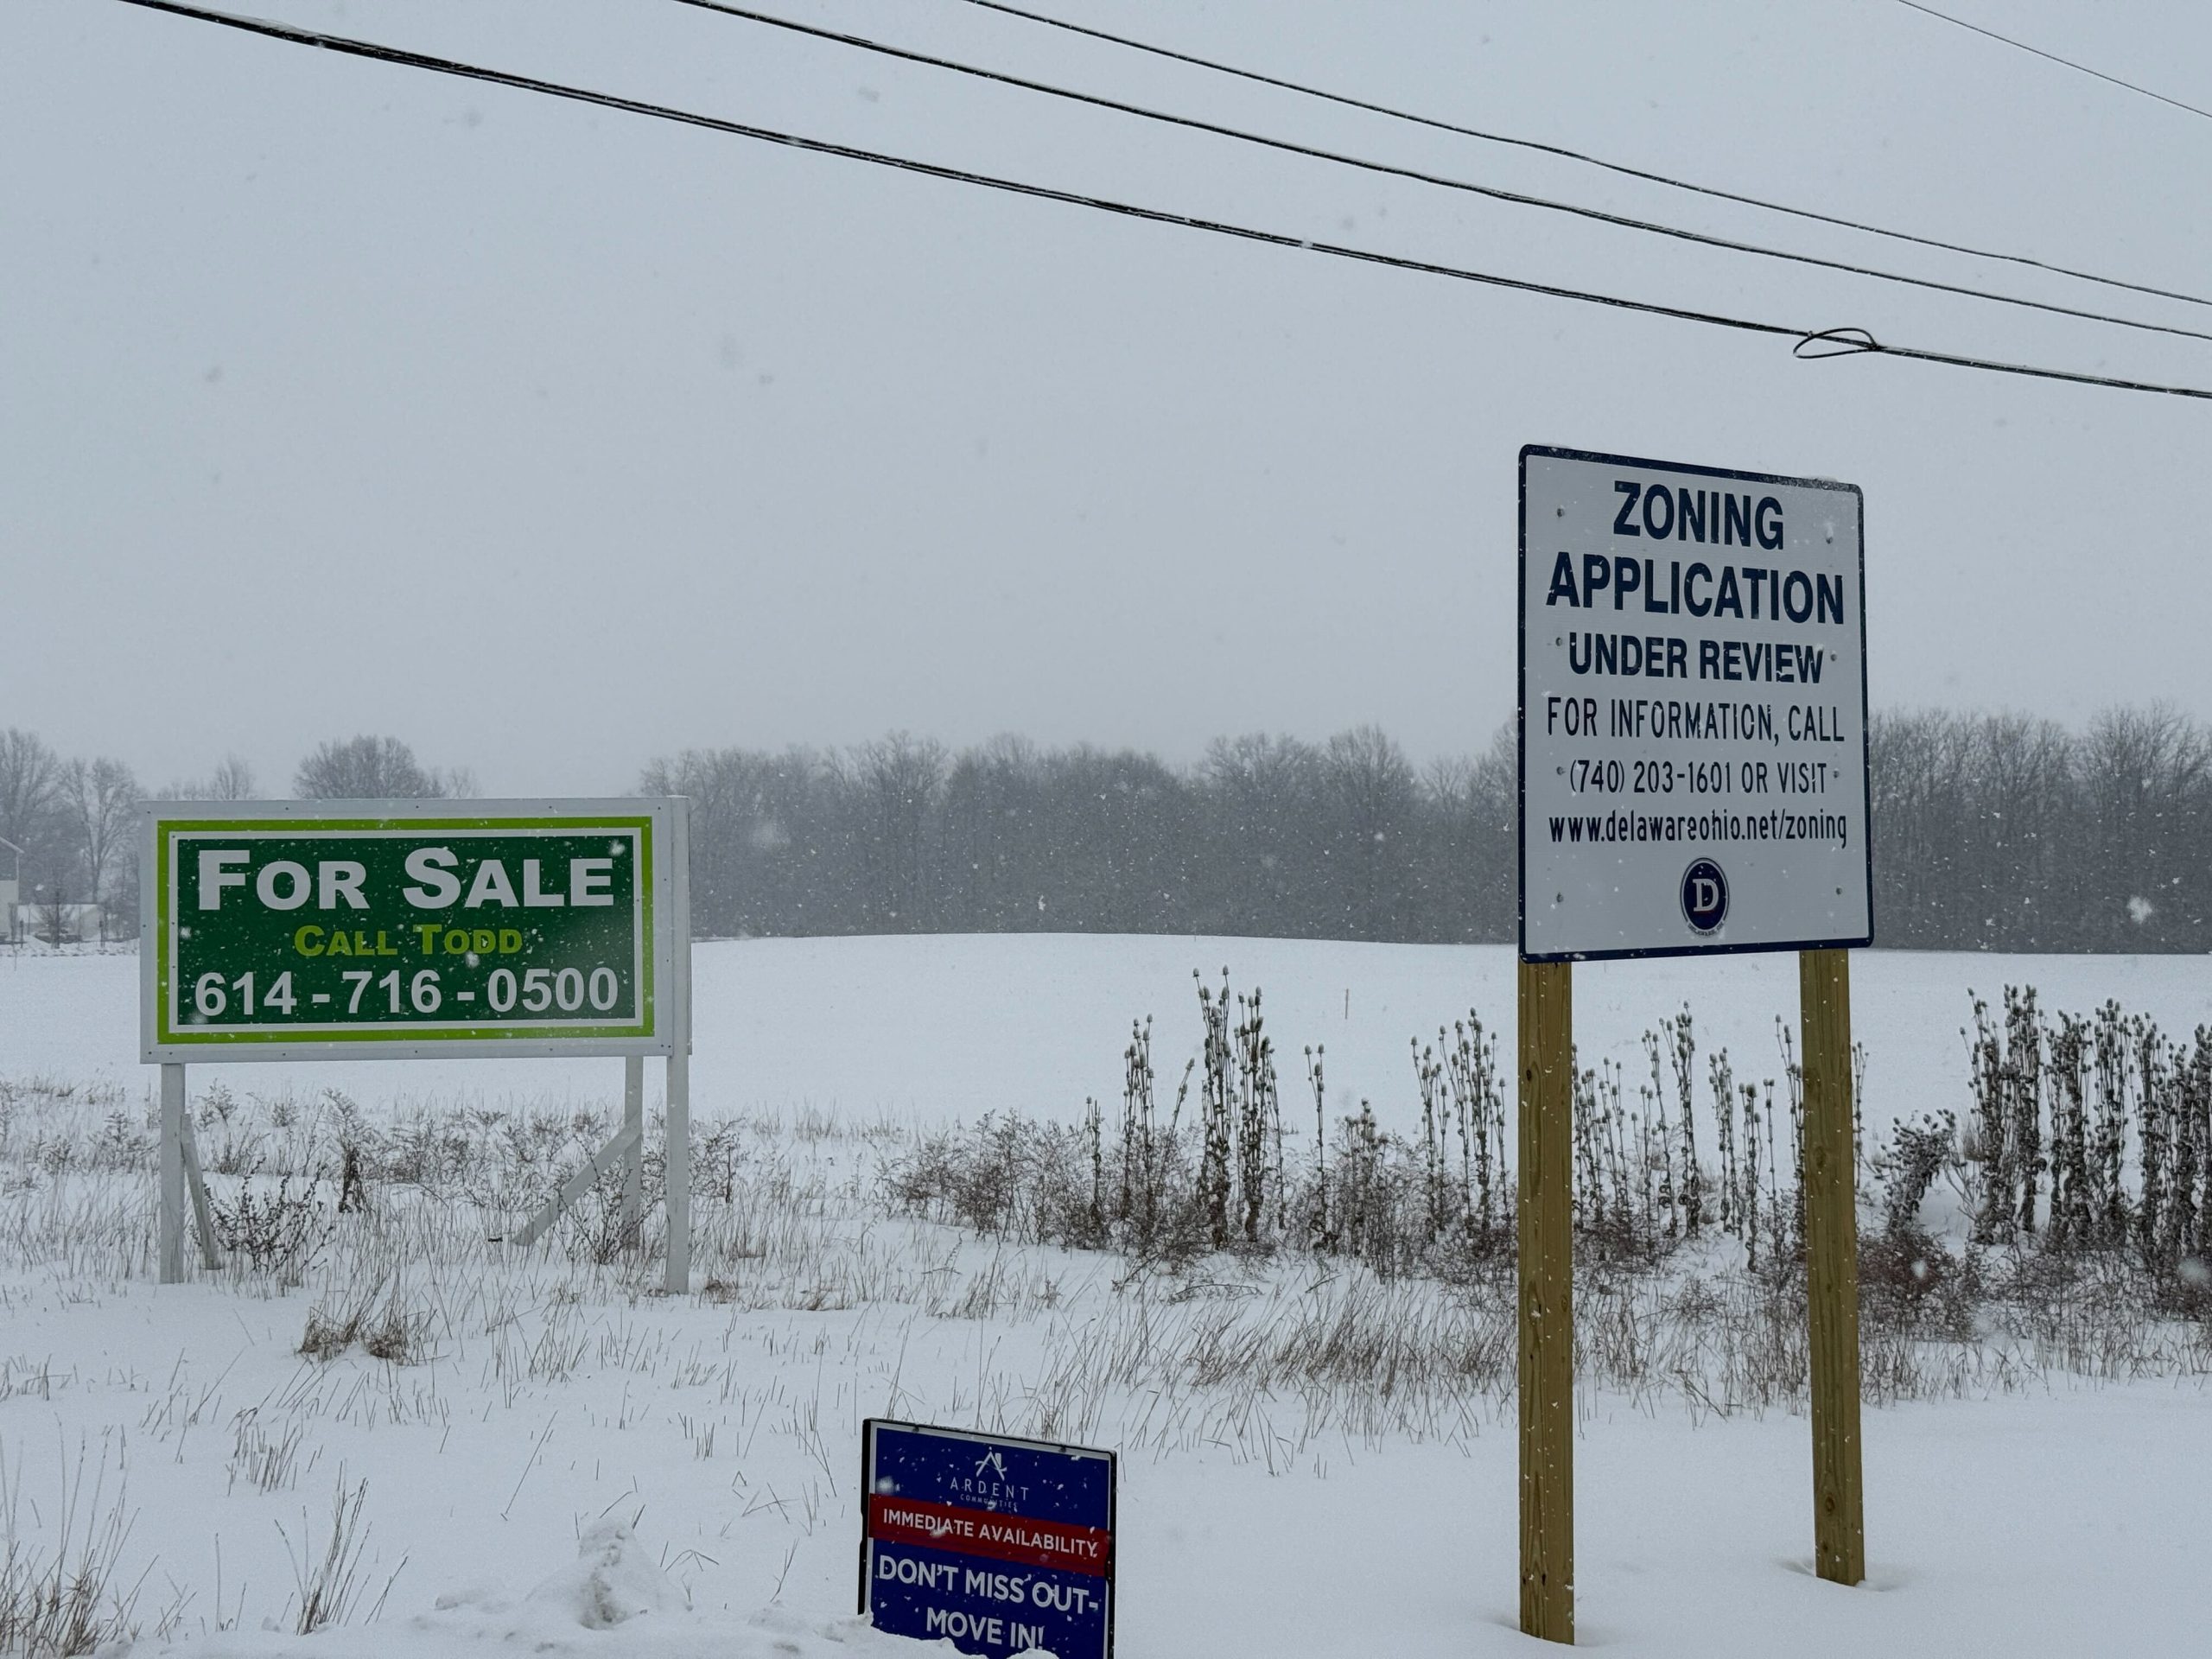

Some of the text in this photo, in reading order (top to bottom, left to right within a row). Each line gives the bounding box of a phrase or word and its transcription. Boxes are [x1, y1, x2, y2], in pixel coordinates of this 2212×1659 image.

[1613, 480, 1785, 550] ZONING
[1546, 551, 1845, 625] APPLICATION
[1568, 632, 1824, 684] UNDER REVIEW
[1547, 696, 1846, 747] FOR INFORMATION, CALL
[1569, 759, 1827, 795] (740) 203-1601 OR VISIT
[1548, 808, 1847, 849] www.delawareohio.net/zoning
[197, 847, 614, 911] FOR SALE
[1692, 878, 1719, 912] D
[294, 924, 523, 957] CALL TODD
[950, 1477, 1029, 1501] ARDENT
[883, 1508, 1098, 1557] IMMEDIATE AVAILABILITY
[879, 1554, 1099, 1614] DON'T MISS OUT-
[926, 1607, 1044, 1650] MOVE IN!
